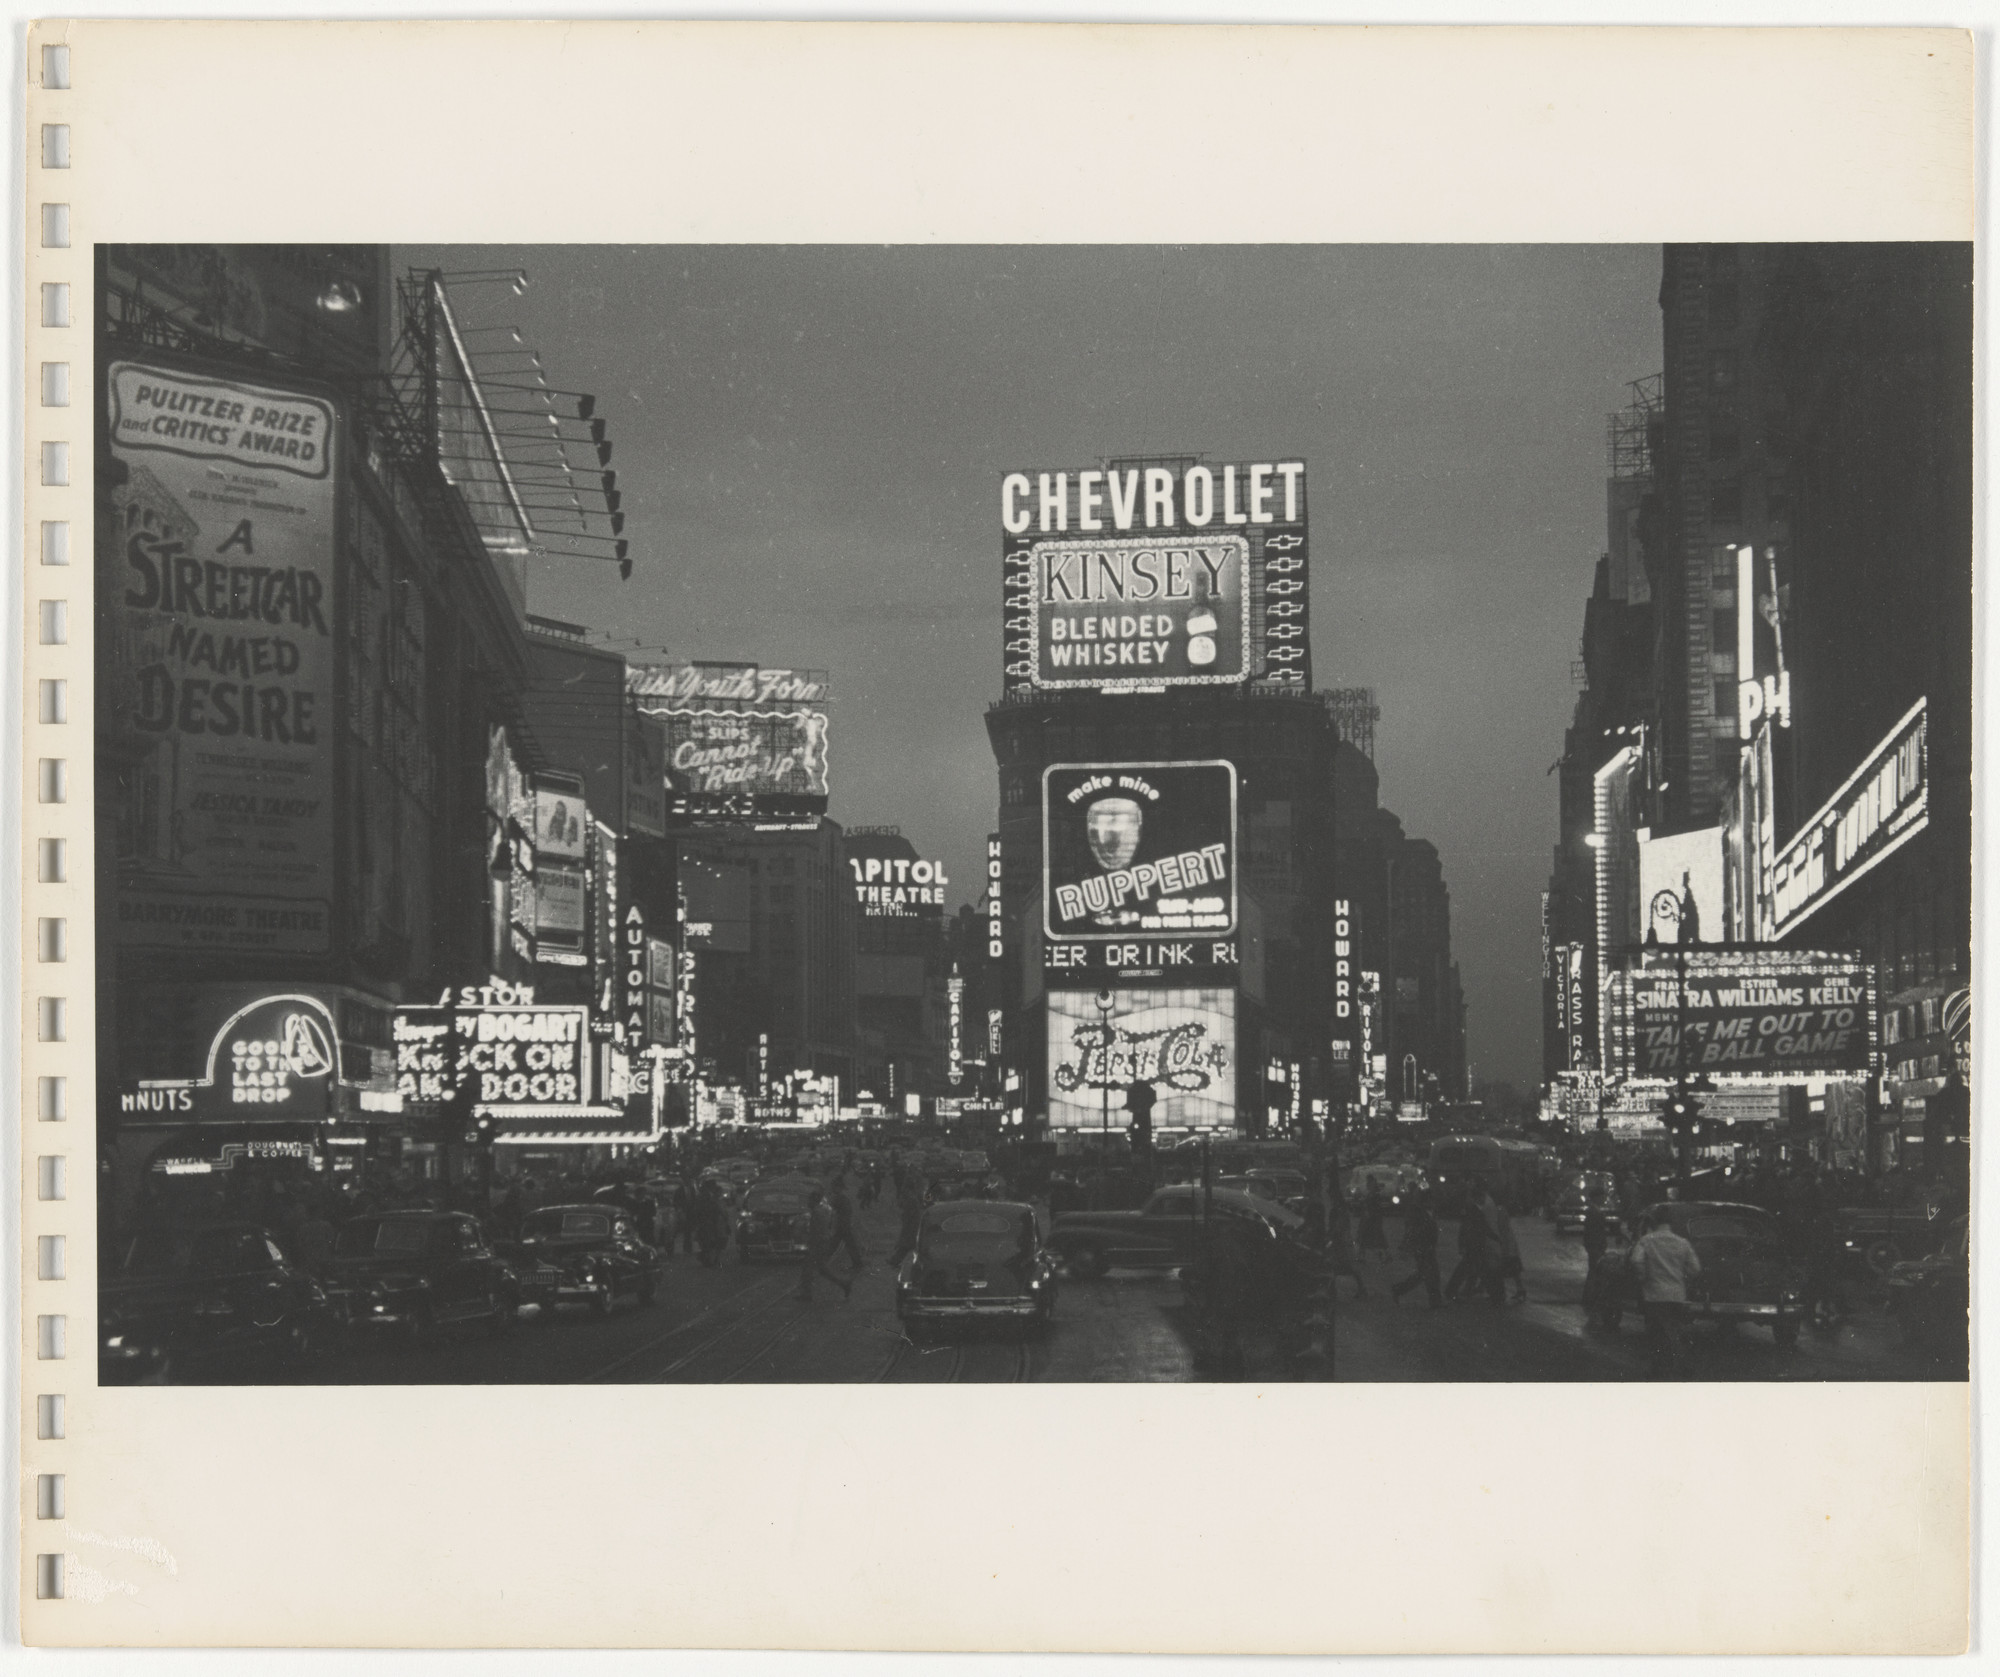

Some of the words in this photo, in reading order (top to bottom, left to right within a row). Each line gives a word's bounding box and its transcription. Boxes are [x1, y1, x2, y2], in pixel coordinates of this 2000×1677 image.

[136, 385, 244, 423] PULITZER
[250, 406, 316, 436] PRIZE
[121, 418, 149, 432] and
[238, 431, 316, 461] AWARD
[1002, 463, 1304, 533] CHEVROLET
[216, 518, 253, 554] A
[125, 531, 330, 637] STREETCAR
[1042, 546, 1235, 604] KINSEY
[1051, 615, 1174, 640] BLENDED
[169, 623, 300, 679] NAMED
[1051, 642, 1169, 667] WHISKEY
[675, 665, 756, 707] Youth
[132, 663, 317, 745] DESIRE
[708, 728, 749, 740] SLIPS
[674, 735, 762, 770] Cannot
[1067, 776, 1112, 803] make
[1119, 776, 1159, 800] mine
[856, 886, 944, 904] THEATRE
[988, 841, 1002, 957] HOWARD
[1056, 843, 1226, 922] RUPPERT
[245, 908, 323, 931] THEATRE
[1541, 892, 1550, 978] WELLINGTON
[1106, 944, 1193, 966] DRINK
[1335, 900, 1349, 1017] HOWARD
[625, 906, 644, 1048] AUTOMAT
[1556, 955, 1565, 1029] VICTORIA
[1740, 979, 1778, 989] ESTHER
[1824, 977, 1850, 987] GENE
[1717, 988, 1804, 1007] WILLIAMS
[1810, 987, 1863, 1005] KELLY
[478, 1013, 581, 1042] BOGART
[950, 991, 960, 1072] CAPITOL
[1363, 1005, 1371, 1076] RIVOLI
[1713, 1017, 1754, 1041] ME
[1758, 1011, 1815, 1036] OUT
[1821, 1008, 1855, 1031] TO
[232, 1057, 262, 1071] TO
[525, 1044, 574, 1071] ON
[1333, 1051, 1349, 1060] LEE
[1701, 1037, 1766, 1064] BALL
[232, 1072, 288, 1087] LAST
[232, 1088, 291, 1103] DROP
[481, 1073, 577, 1101] DOOR
[754, 1107, 791, 1118] ROTHS
